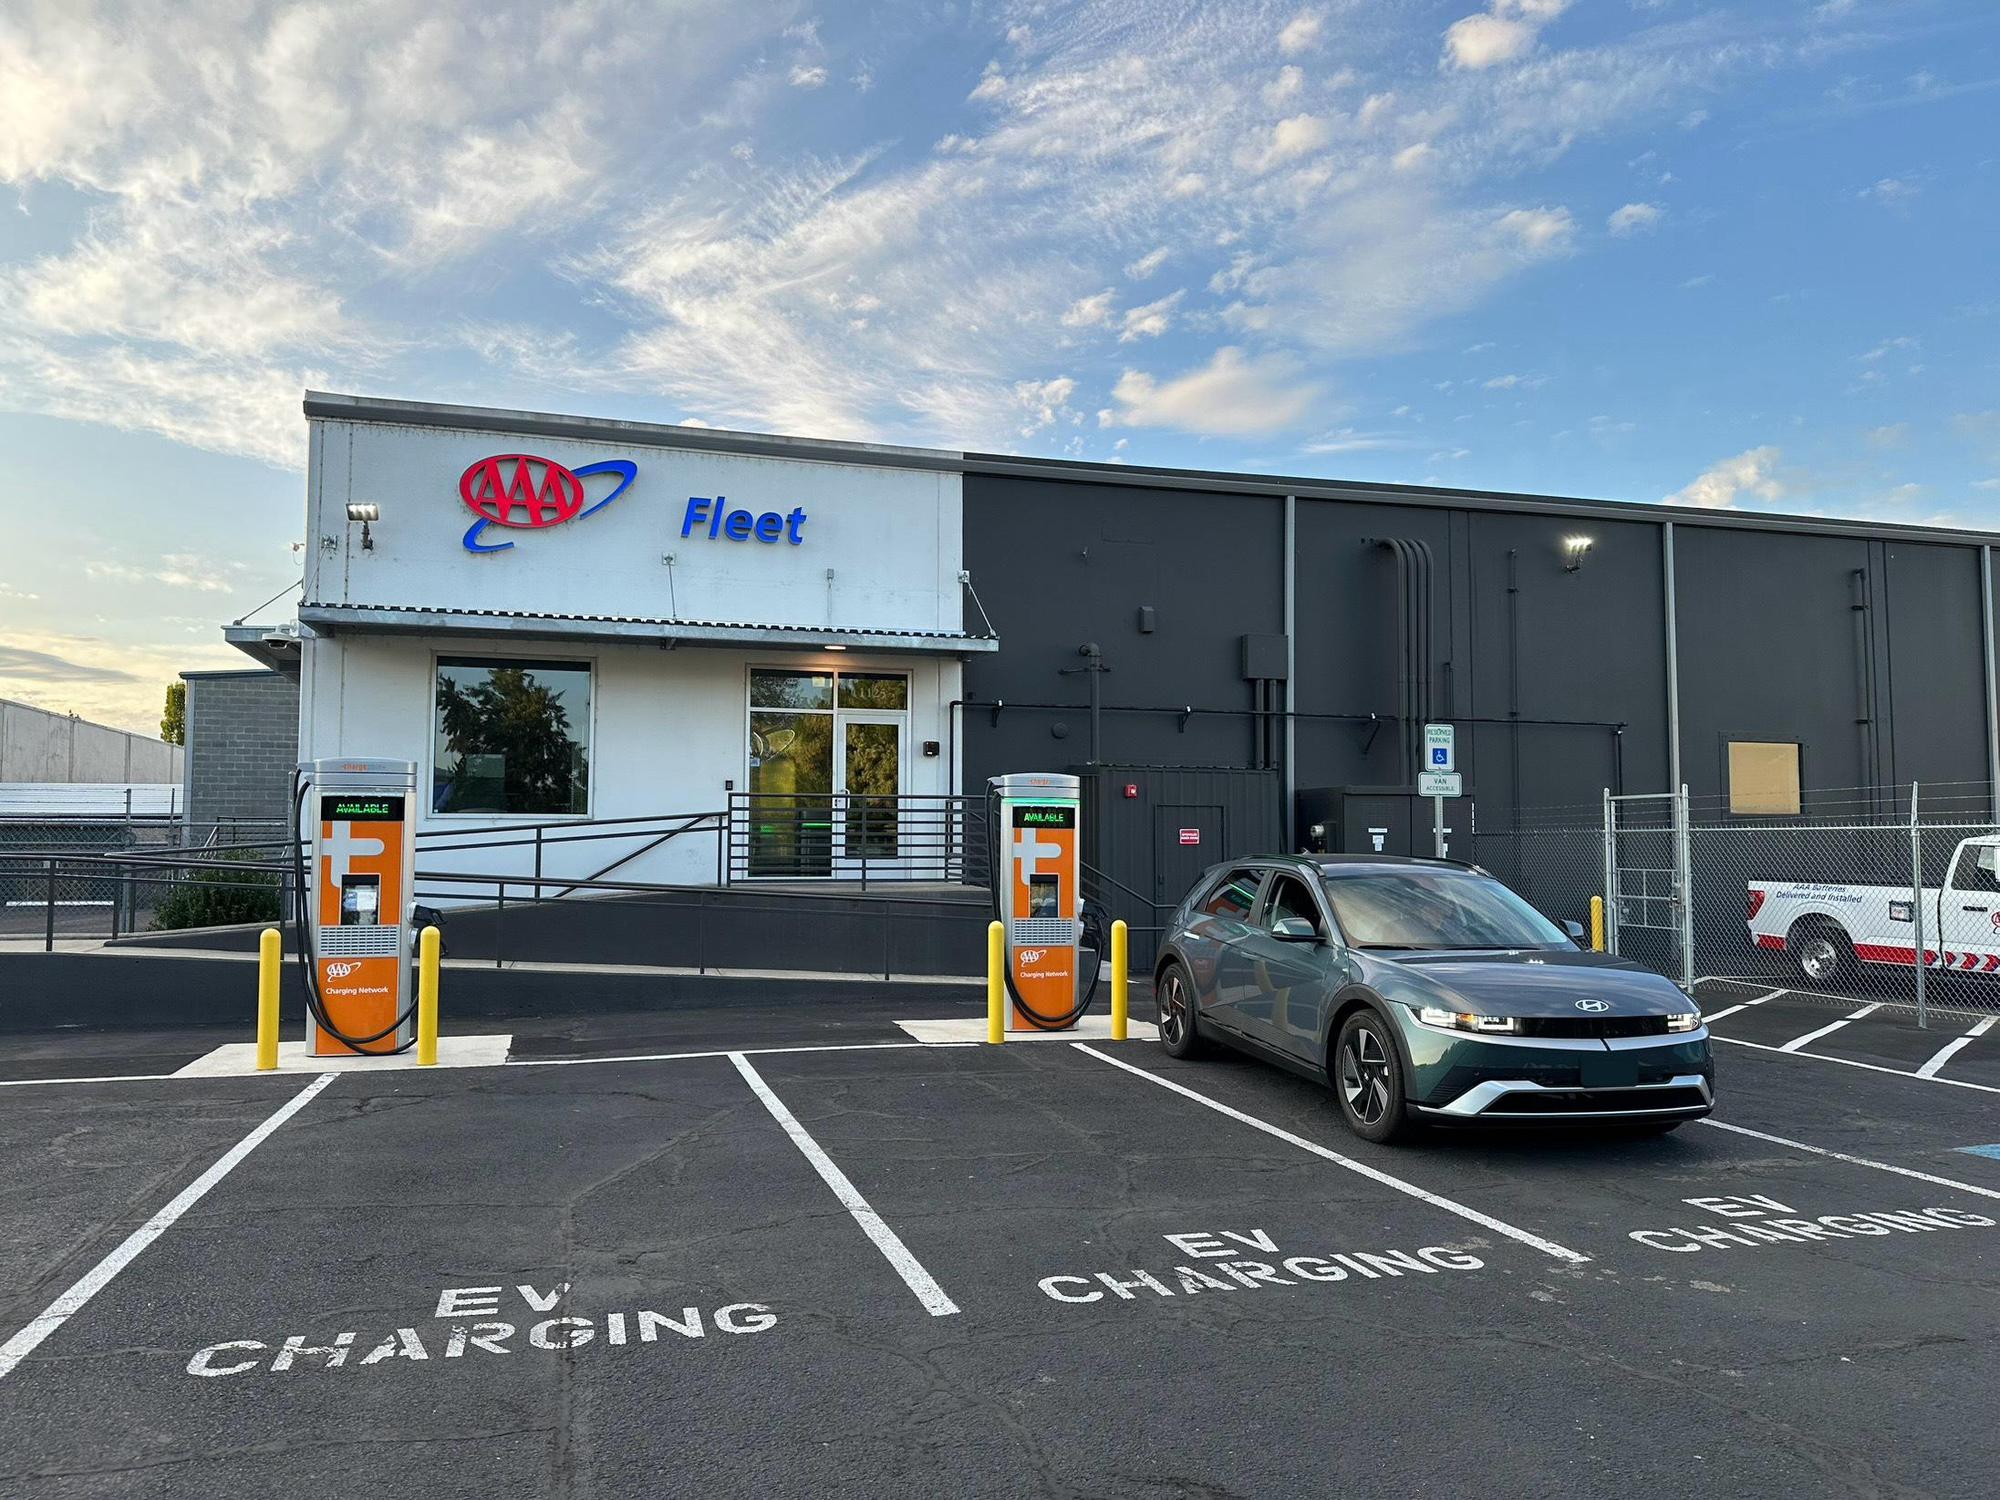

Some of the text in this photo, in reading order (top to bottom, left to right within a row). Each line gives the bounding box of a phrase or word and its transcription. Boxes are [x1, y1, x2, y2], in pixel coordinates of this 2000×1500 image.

[472, 455, 575, 527] AAA
[680, 496, 808, 545] Fleet
[1024, 812, 1064, 822] AVAILABLE
[1776, 890, 1811, 899] Delivered
[1828, 893, 1862, 903] Installed
[1812, 884, 1846, 892] Batteries
[1020, 971, 1045, 979] Charging
[325, 986, 389, 995] Charging Network
[1681, 1194, 1797, 1217] EV
[1162, 1228, 1280, 1258] EV
[1629, 1207, 1996, 1252] CHARGING
[1037, 1246, 1485, 1303] CHARGING
[435, 1282, 571, 1318] EV
[186, 1303, 778, 1377] CHARGING
